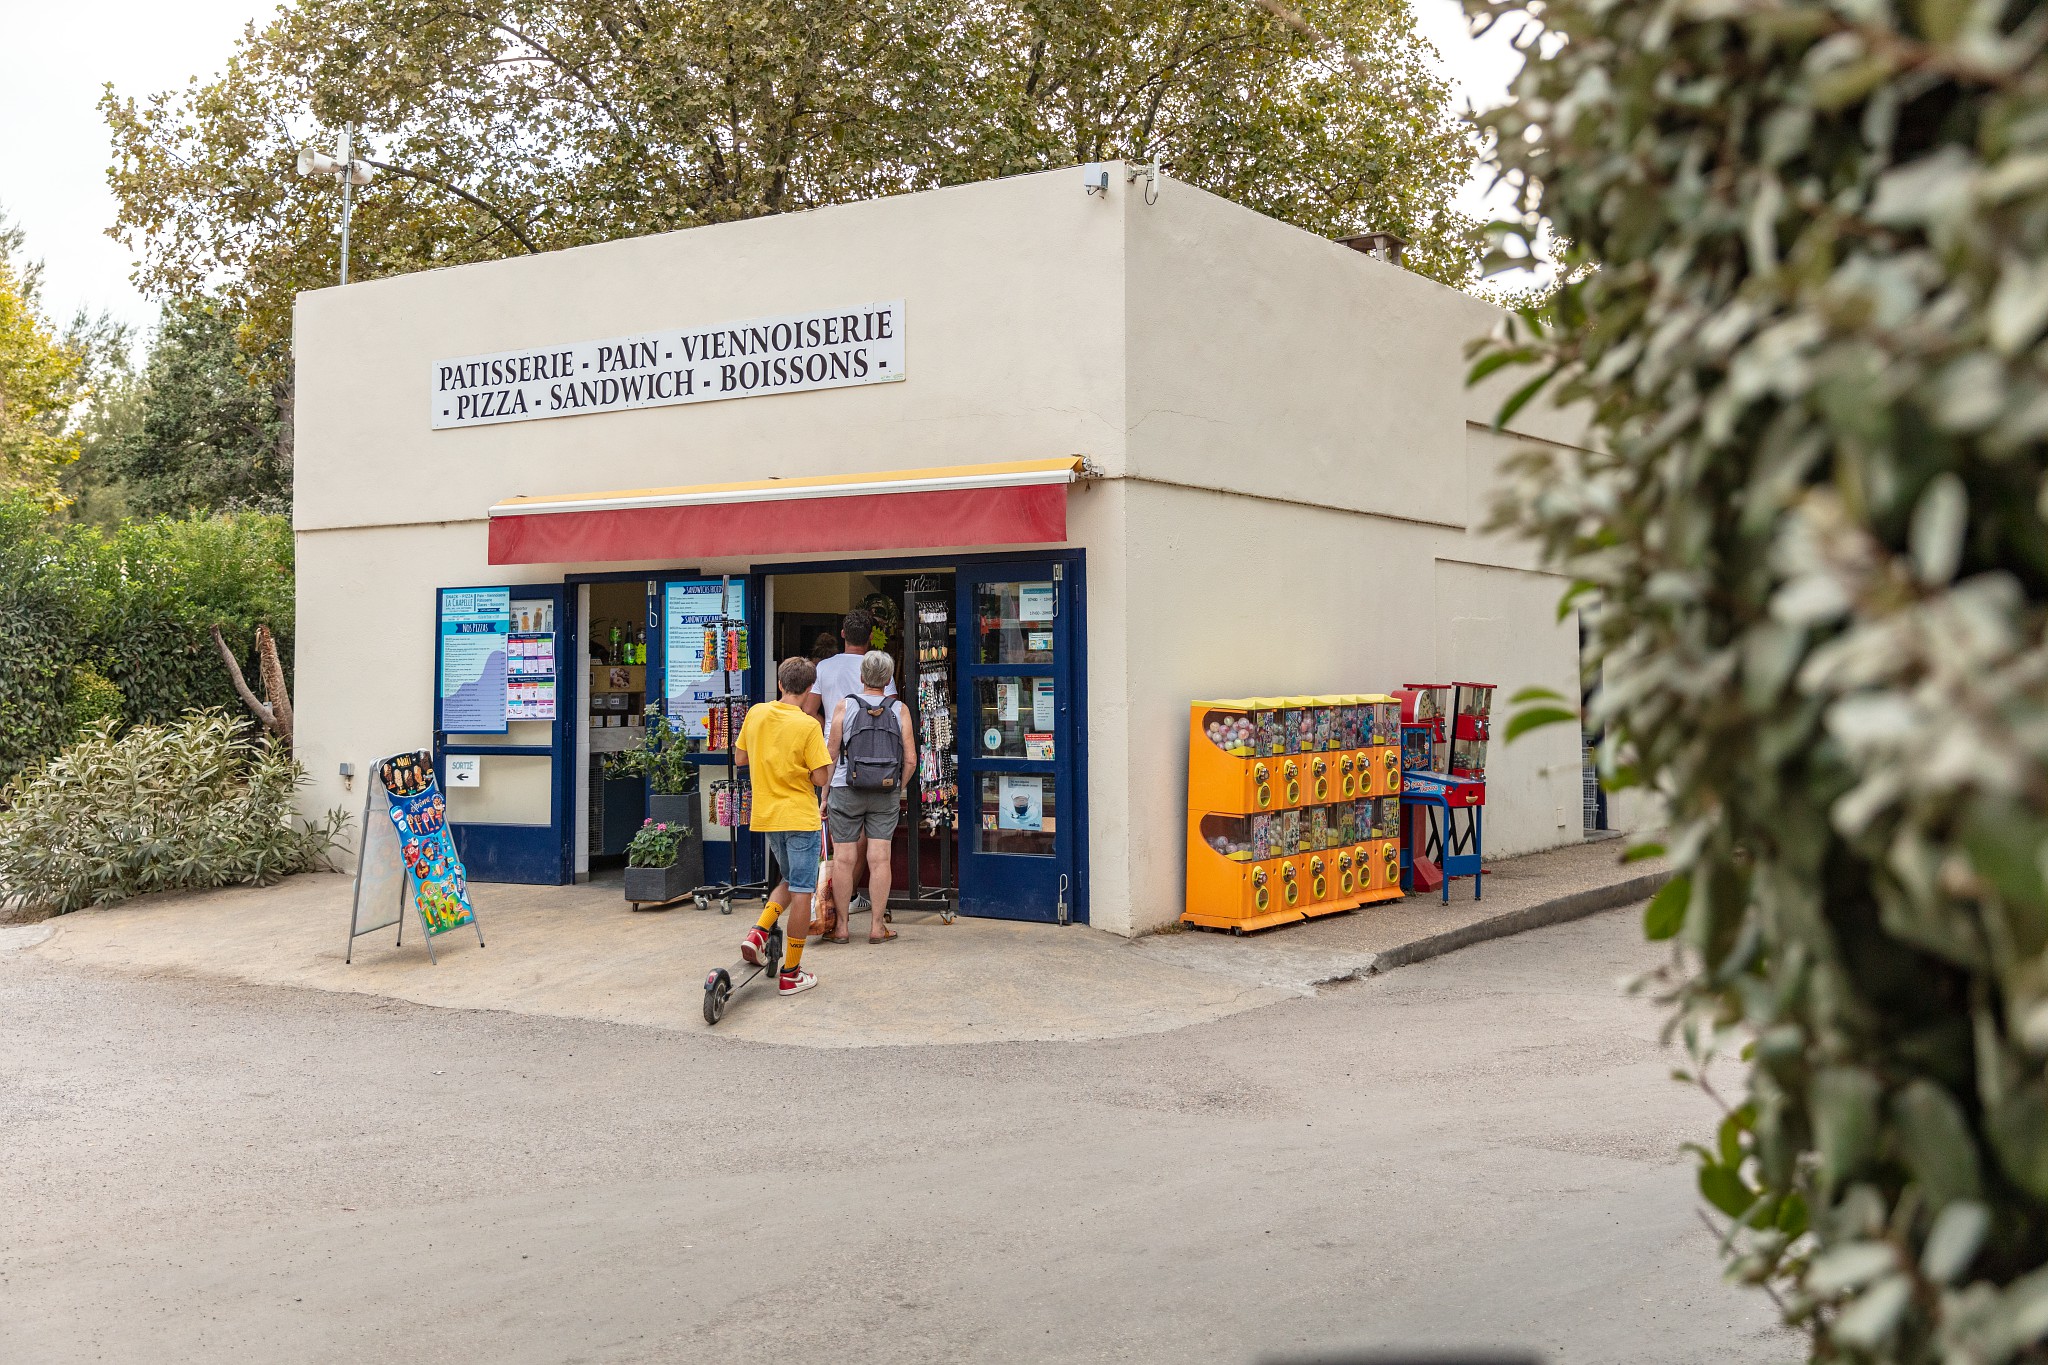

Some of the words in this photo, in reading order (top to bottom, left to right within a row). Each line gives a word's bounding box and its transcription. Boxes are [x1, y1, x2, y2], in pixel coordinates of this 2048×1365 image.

[440, 351, 574, 392] PATISSERIE
[598, 341, 659, 374] PAIN
[681, 310, 894, 363] VIENNOISERIE
[457, 388, 529, 421] PIZZA
[550, 369, 695, 412] SANDWICH
[720, 348, 869, 393] BOISSONS
[472, 623, 489, 633] PIZZAS
[451, 761, 474, 770] SORTIE
